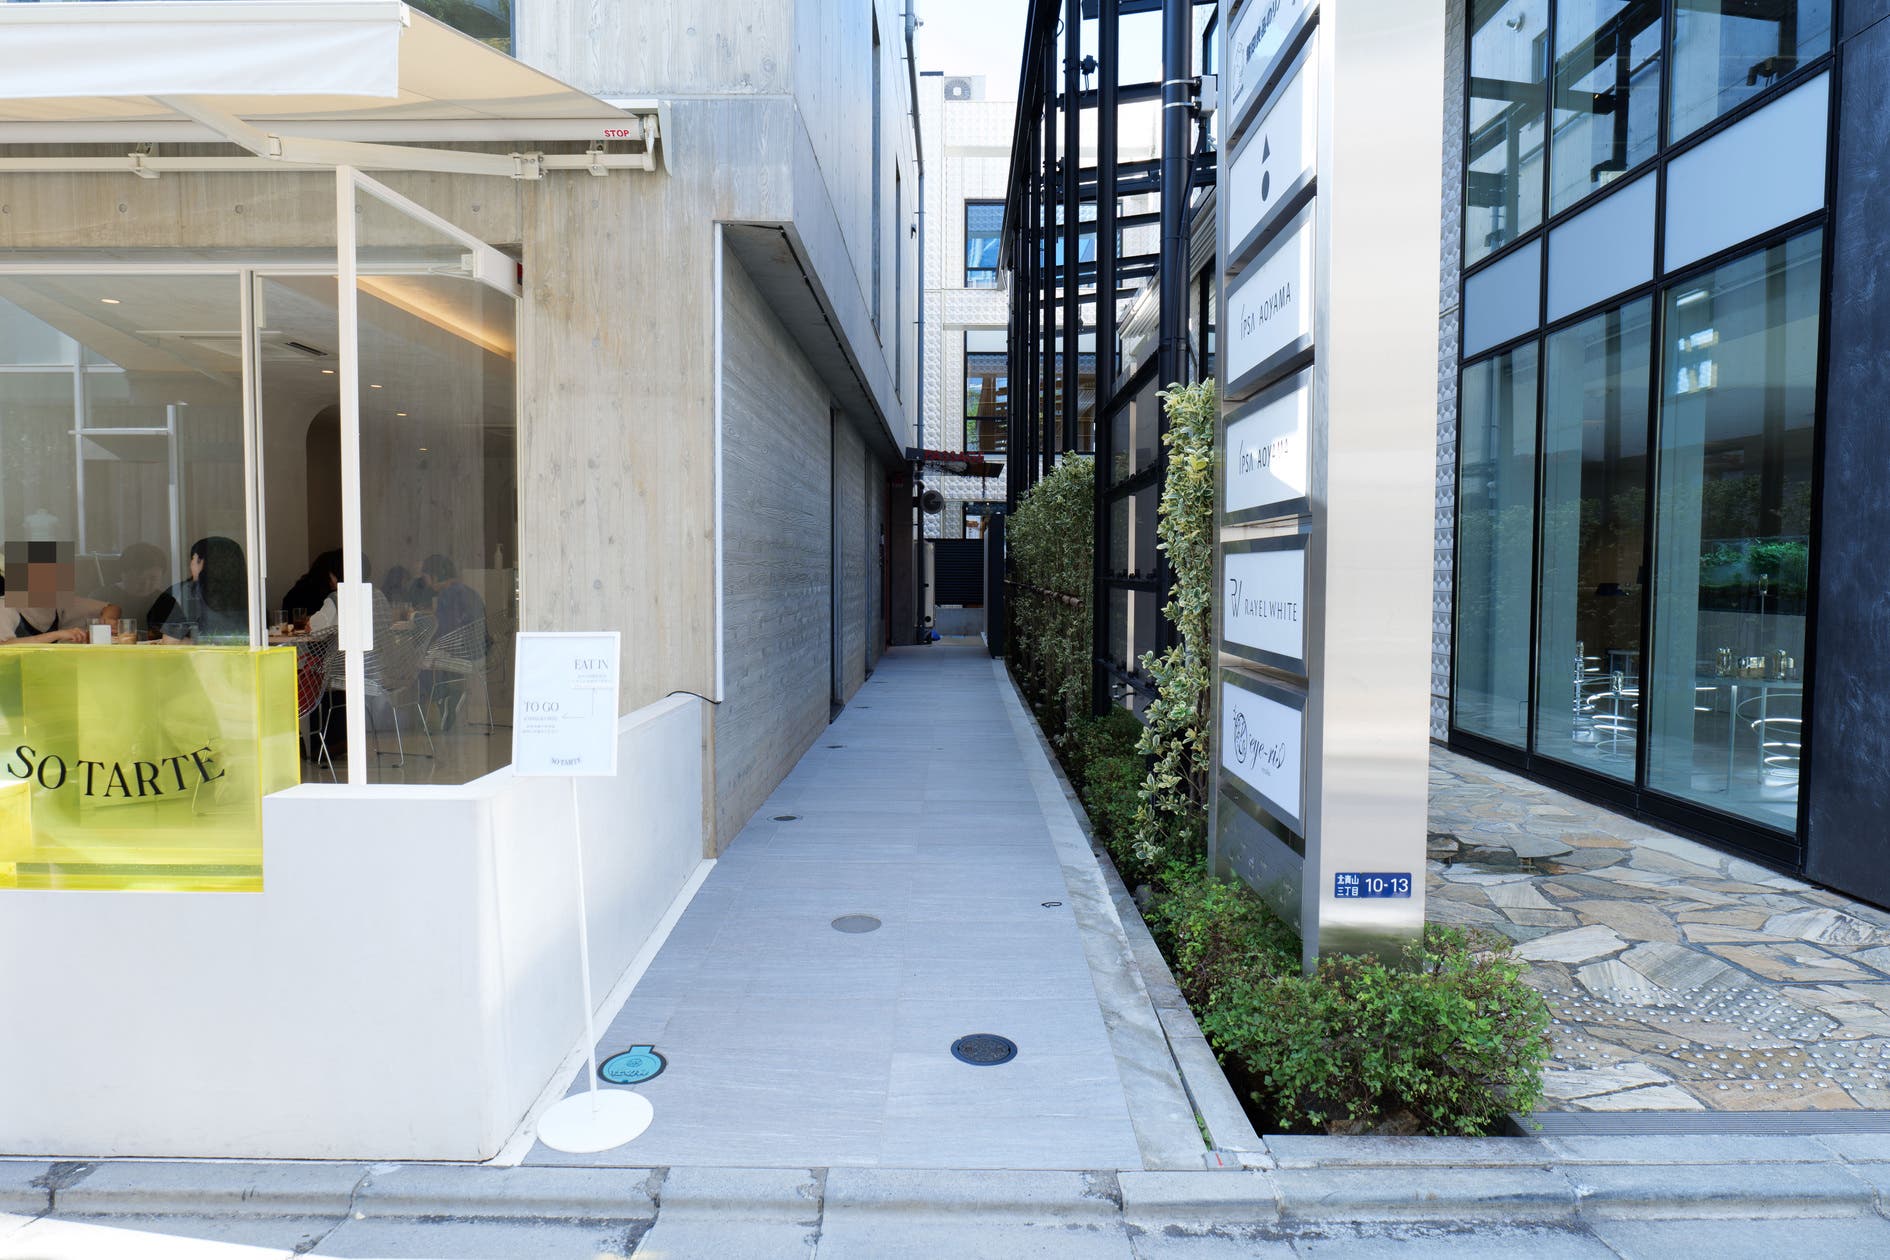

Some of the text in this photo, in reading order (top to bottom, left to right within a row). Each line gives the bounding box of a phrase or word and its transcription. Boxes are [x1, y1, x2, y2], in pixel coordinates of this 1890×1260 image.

[604, 129, 630, 137] STOP
[1259, 281, 1291, 326] AOYAMA
[1244, 598, 1297, 622] RAYEL WHITE
[574, 659, 608, 670] EAT IN
[524, 701, 560, 712] TO GO
[8, 745, 225, 798] SO TARTE
[1337, 874, 1360, 885] 北青山
[1337, 886, 1359, 896] 三丁目
[1365, 878, 1409, 893] 10-13
